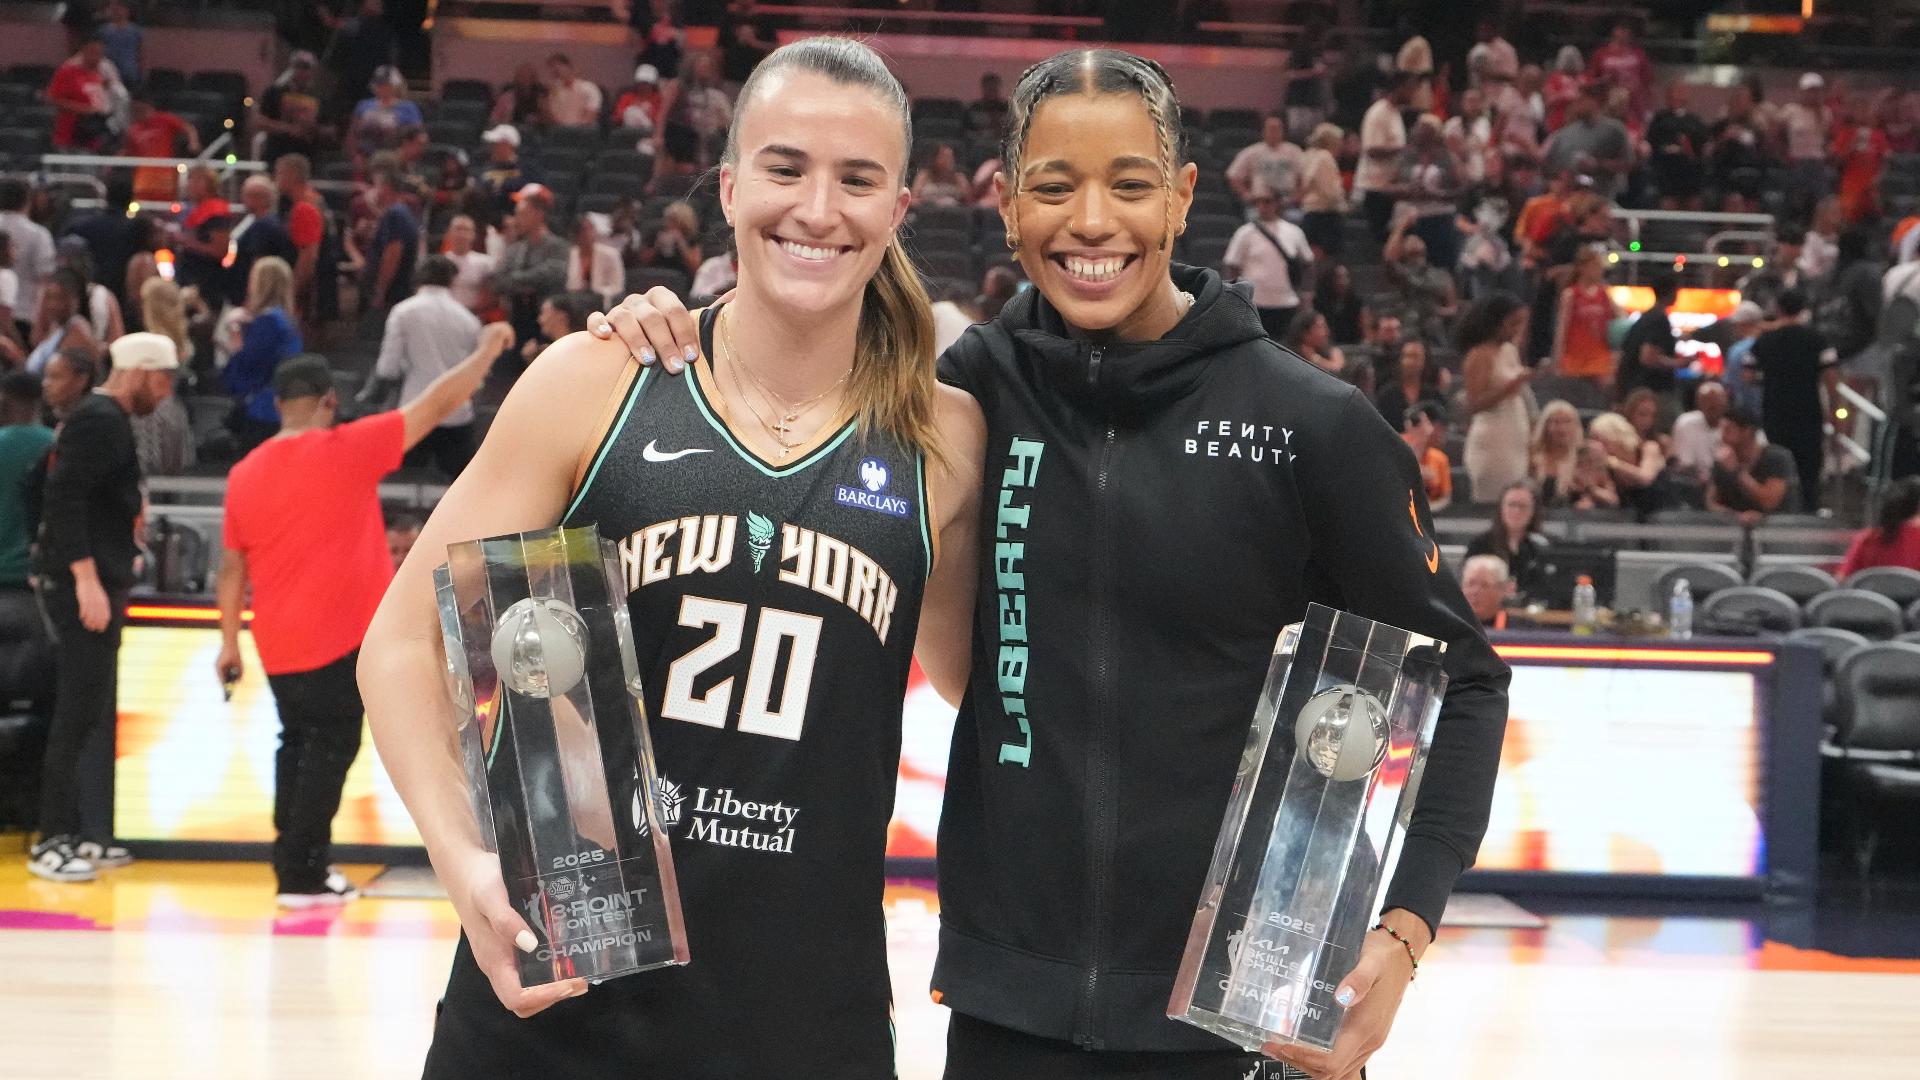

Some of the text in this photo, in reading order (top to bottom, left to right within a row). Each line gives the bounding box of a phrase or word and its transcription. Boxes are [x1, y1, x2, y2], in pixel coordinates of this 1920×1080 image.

[1184, 438, 1297, 465] BEAUTY
[838, 487, 907, 515] BARCLAYS
[617, 515, 898, 647] NEW YORK
[997, 436, 1045, 768] LIBERTY
[660, 594, 824, 741] 20
[693, 787, 800, 834] Liberty
[683, 816, 796, 854] Mutual
[552, 848, 605, 869] 2025
[565, 907, 636, 930] ONTEST
[1268, 911, 1315, 934] 2025
[535, 929, 652, 962] CHAMPION
[1246, 947, 1301, 972] SKILLS
